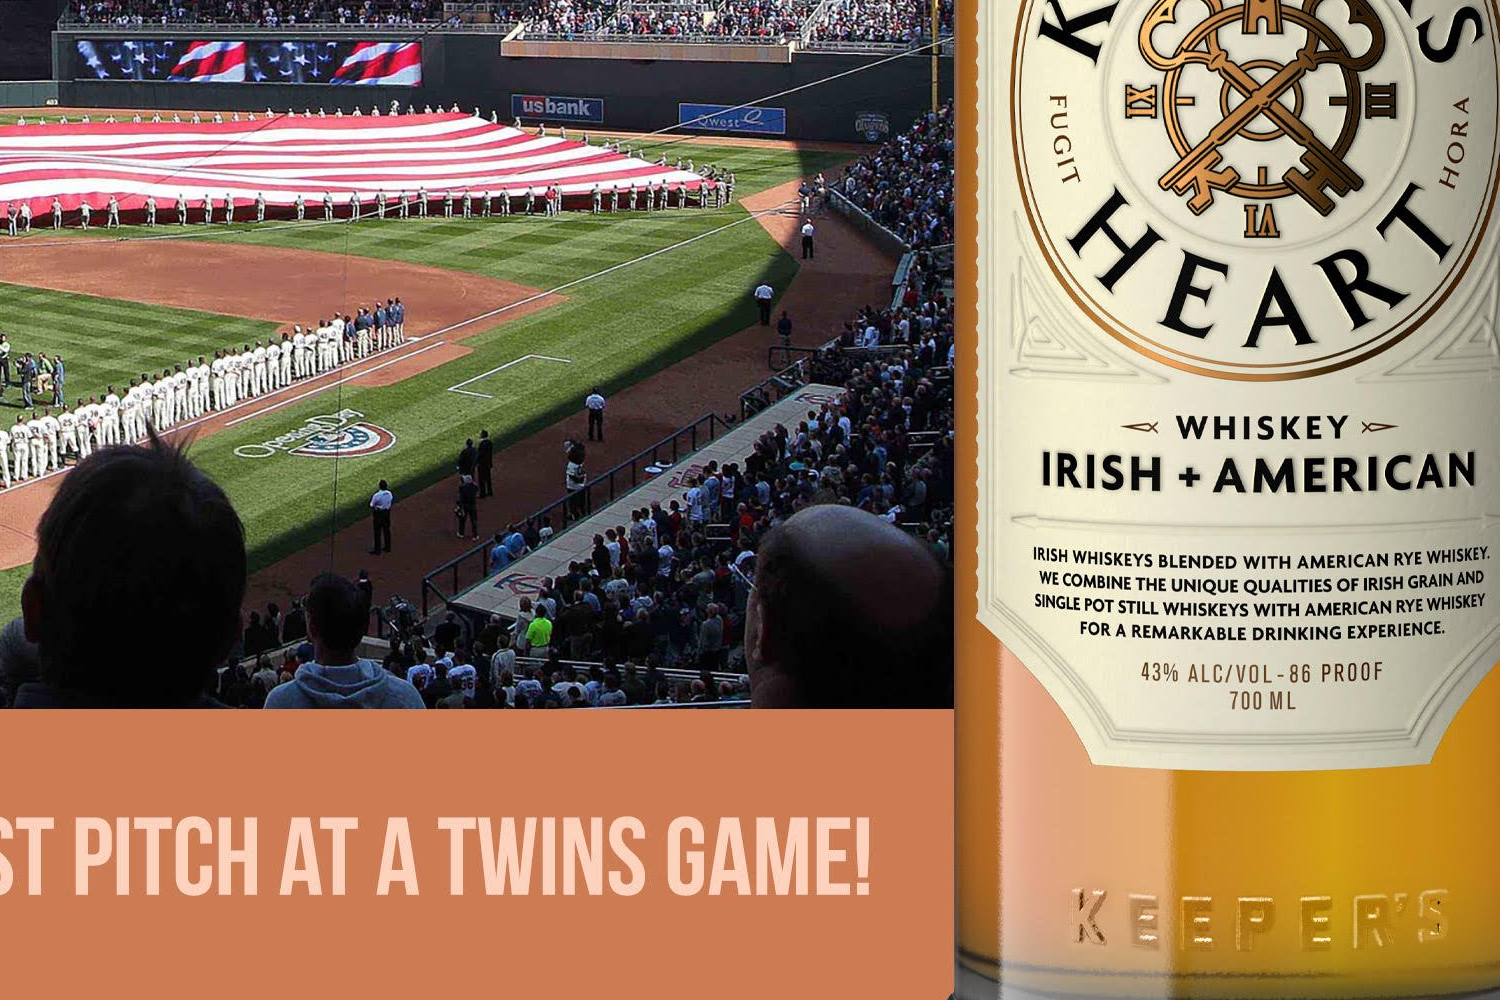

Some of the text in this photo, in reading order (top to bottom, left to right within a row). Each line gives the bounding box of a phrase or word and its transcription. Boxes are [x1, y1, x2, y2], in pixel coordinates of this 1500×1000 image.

[698, 114, 740, 128] Qwest
[1049, 95, 1081, 185] FUGIT
[1438, 96, 1469, 190] HORA
[1066, 183, 1454, 348] HEART
[1176, 415, 1348, 440] WHISKEY
[1042, 451, 1161, 492] IRISH
[1212, 451, 1476, 494] AMERICAN
[1033, 545, 1490, 570] IRISH WHISKEYS BLENDED WITH AMERICAN RYE WHISKEY.
[1039, 570, 1485, 595] WE COMBINE THE UNIQUE QUALITIES OF IRISH GRAIN AND
[1034, 592, 1486, 618] SINGLE POT STILL WHISKEYS WITH AMERICAN RYE WHISKEY
[1080, 620, 1445, 641] FOR A REMARKABLE DRINKING EXPERIENCE.
[1141, 661, 1179, 682] 43%
[1321, 661, 1383, 683] PROOF
[1230, 690, 1296, 711] 700 ML
[1071, 888, 1449, 951] KEEPER'S
